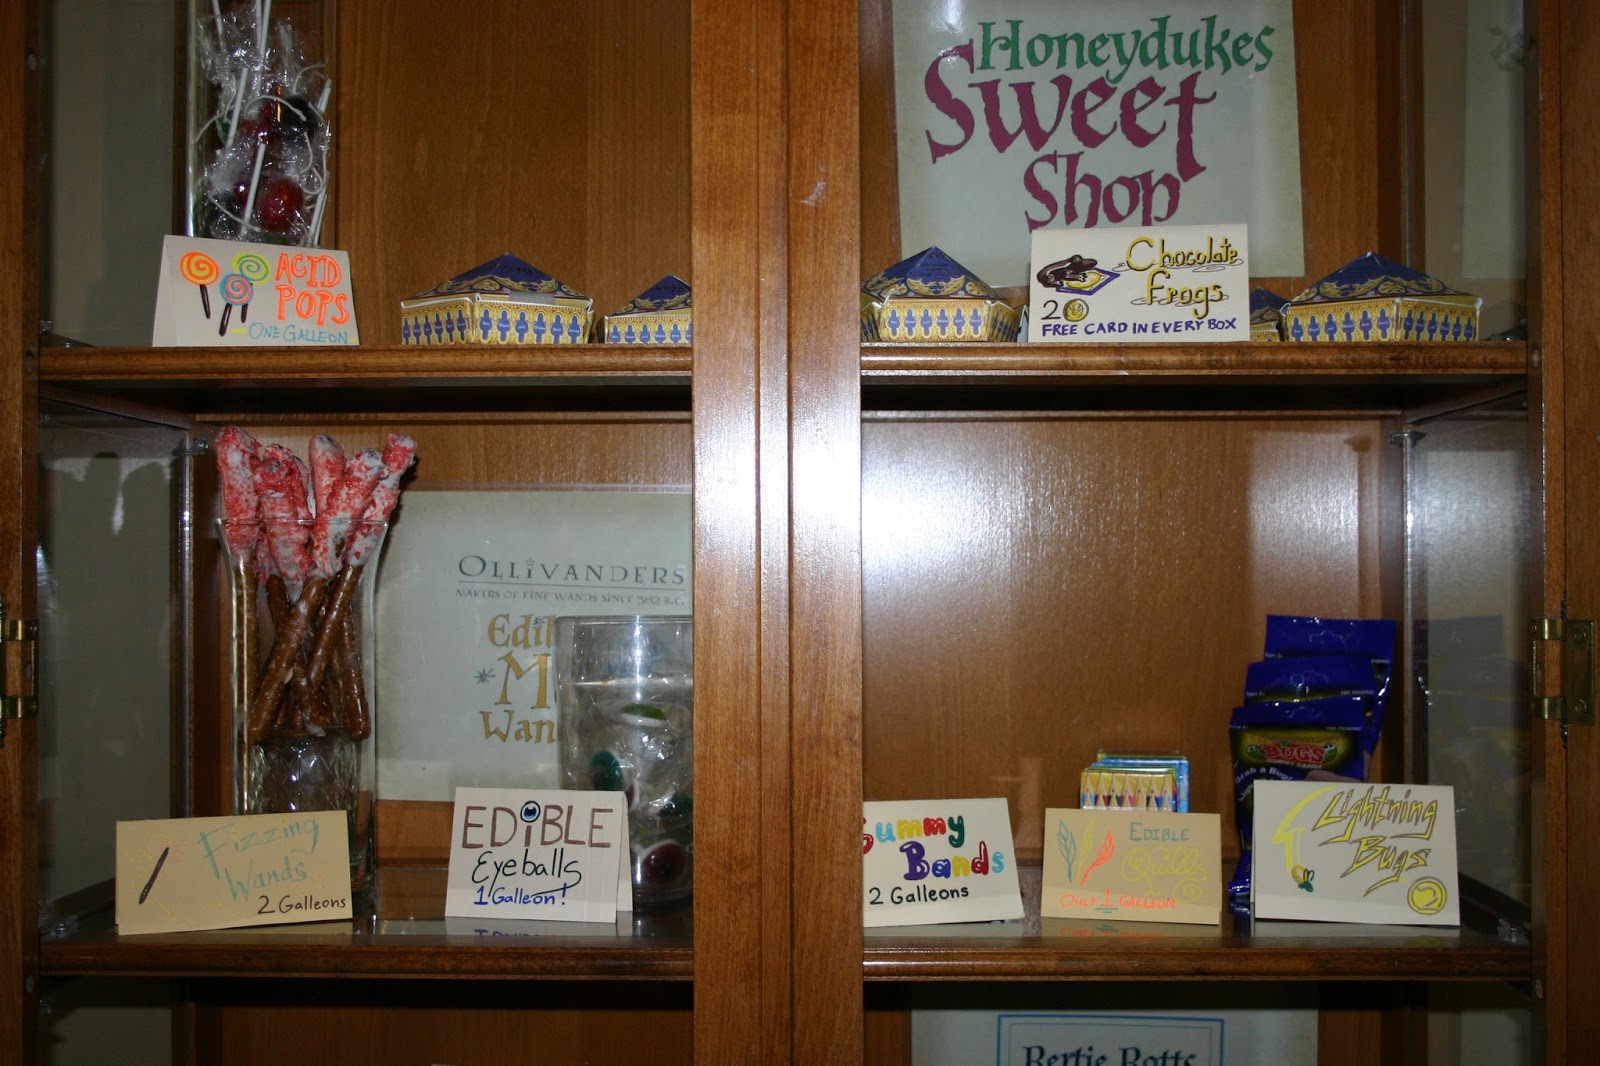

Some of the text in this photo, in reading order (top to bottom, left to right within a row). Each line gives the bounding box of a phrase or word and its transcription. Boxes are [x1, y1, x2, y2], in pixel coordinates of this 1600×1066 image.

[977, 15, 1275, 84] Honeydukes
[924, 38, 1218, 182] Sweet
[1023, 150, 1181, 232] Shop
[275, 252, 342, 288] ACID
[1125, 236, 1239, 272] Chocolate
[275, 284, 350, 326] POPS
[1146, 267, 1224, 320] Frogs
[249, 322, 348, 345] ONE GALLEON
[1042, 317, 1237, 337] FREE CARD IN EVERY BOX
[503, 591, 518, 599] OF
[480, 709, 556, 744] Wan
[1261, 744, 1325, 764] BUGS
[1129, 821, 1191, 841] EDIBLE
[1311, 785, 1438, 847] Lightning
[197, 818, 319, 880] Fizzing
[899, 840, 1005, 881] Bands
[1339, 835, 1431, 897] Bugs
[225, 856, 308, 904] Wands
[471, 848, 582, 897] Eyeballs
[257, 894, 346, 914] 2 Galleons
[473, 882, 568, 906] 1 Galleon!
[869, 884, 969, 905] 2 Galleons
[1060, 889, 1176, 910] ONLY 1 GALLEON
